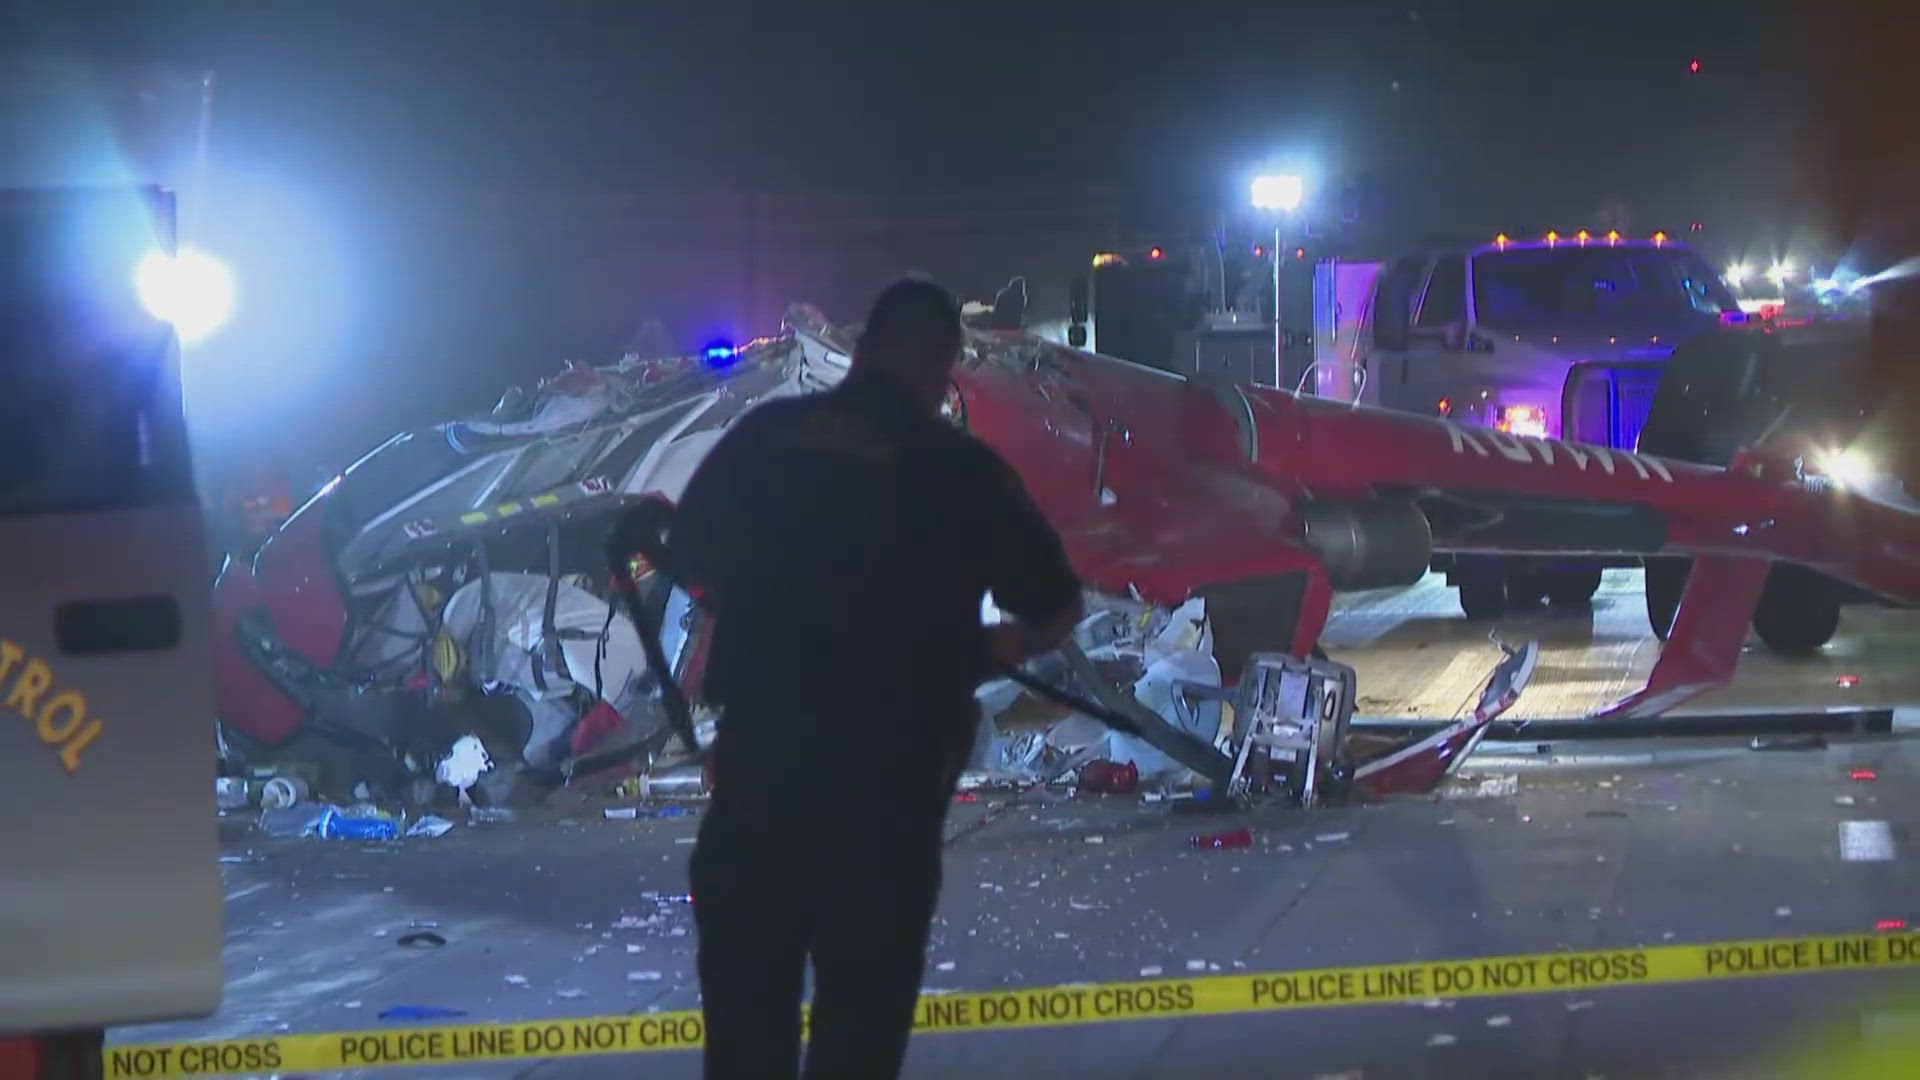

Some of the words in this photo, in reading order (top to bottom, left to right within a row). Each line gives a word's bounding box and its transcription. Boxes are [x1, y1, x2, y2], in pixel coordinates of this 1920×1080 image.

[1706, 942, 1810, 973] POLICE
[1817, 938, 1879, 966] LINE
[1252, 972, 1354, 1004] POLICE
[1363, 968, 1425, 997] LINE
[1433, 965, 1474, 992] DO
[1482, 960, 1540, 989] NOT
[1548, 952, 1649, 985] CROSS
[979, 996, 1021, 1024] DO
[1028, 992, 1085, 1019] NOT
[1094, 984, 1195, 1016] CROSS
[112, 1047, 173, 1077] NOT
[179, 1042, 282, 1074] CROSS
[340, 1032, 445, 1064] POLICE
[452, 1028, 516, 1057] LINE
[523, 1025, 565, 1052] DO
[573, 1020, 632, 1050] NOT
[639, 1017, 702, 1047] CRO
